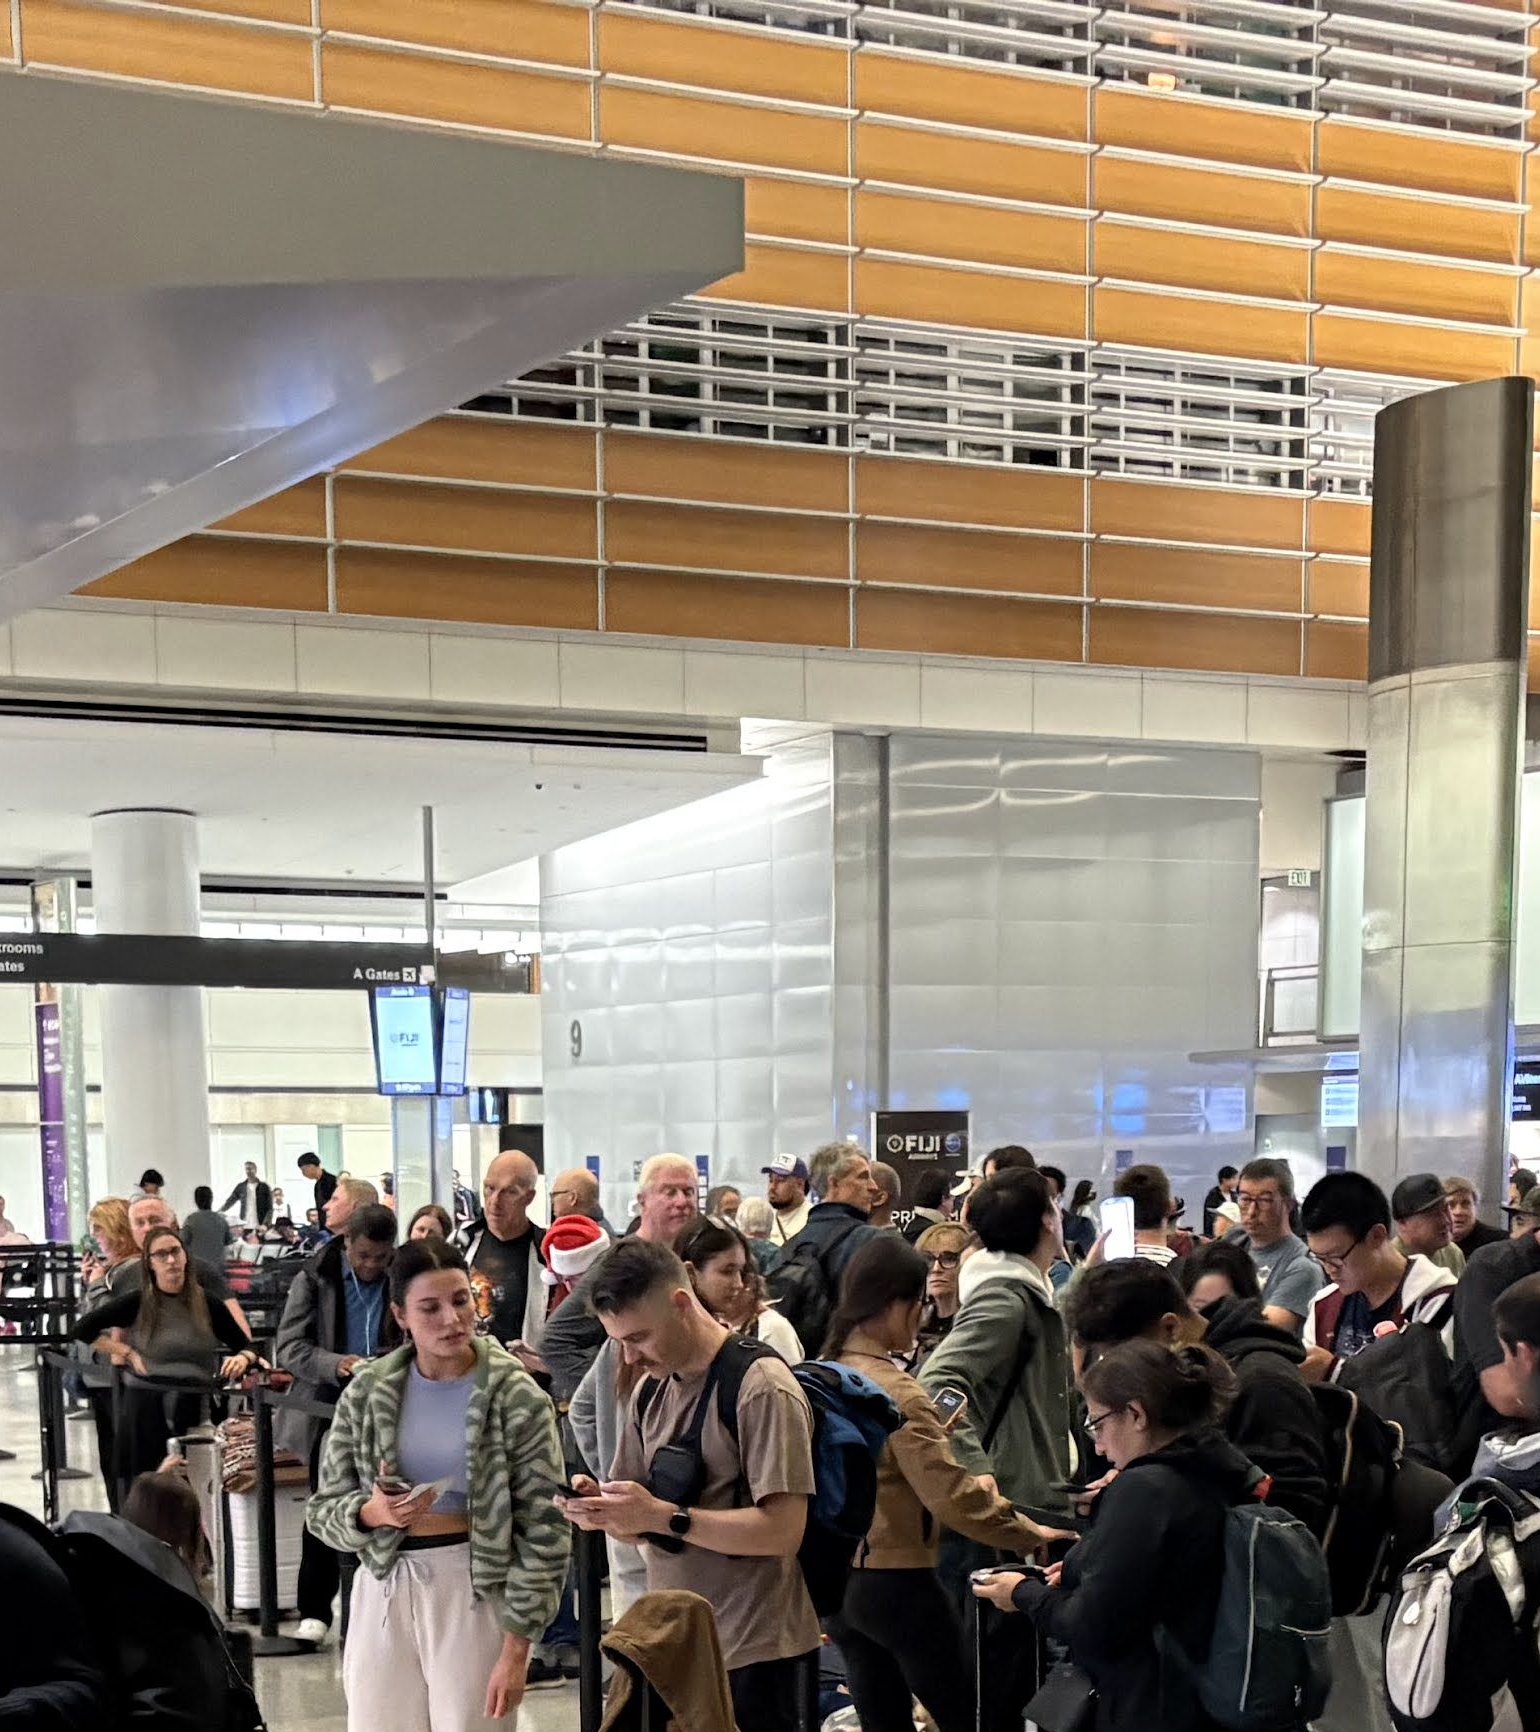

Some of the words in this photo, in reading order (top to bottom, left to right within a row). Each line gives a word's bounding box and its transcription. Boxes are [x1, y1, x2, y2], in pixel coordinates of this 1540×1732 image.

[353, 967, 364, 980] A
[365, 967, 401, 981] Gates
[570, 1018, 583, 1060] 9
[905, 1135, 941, 1152] FIJI
